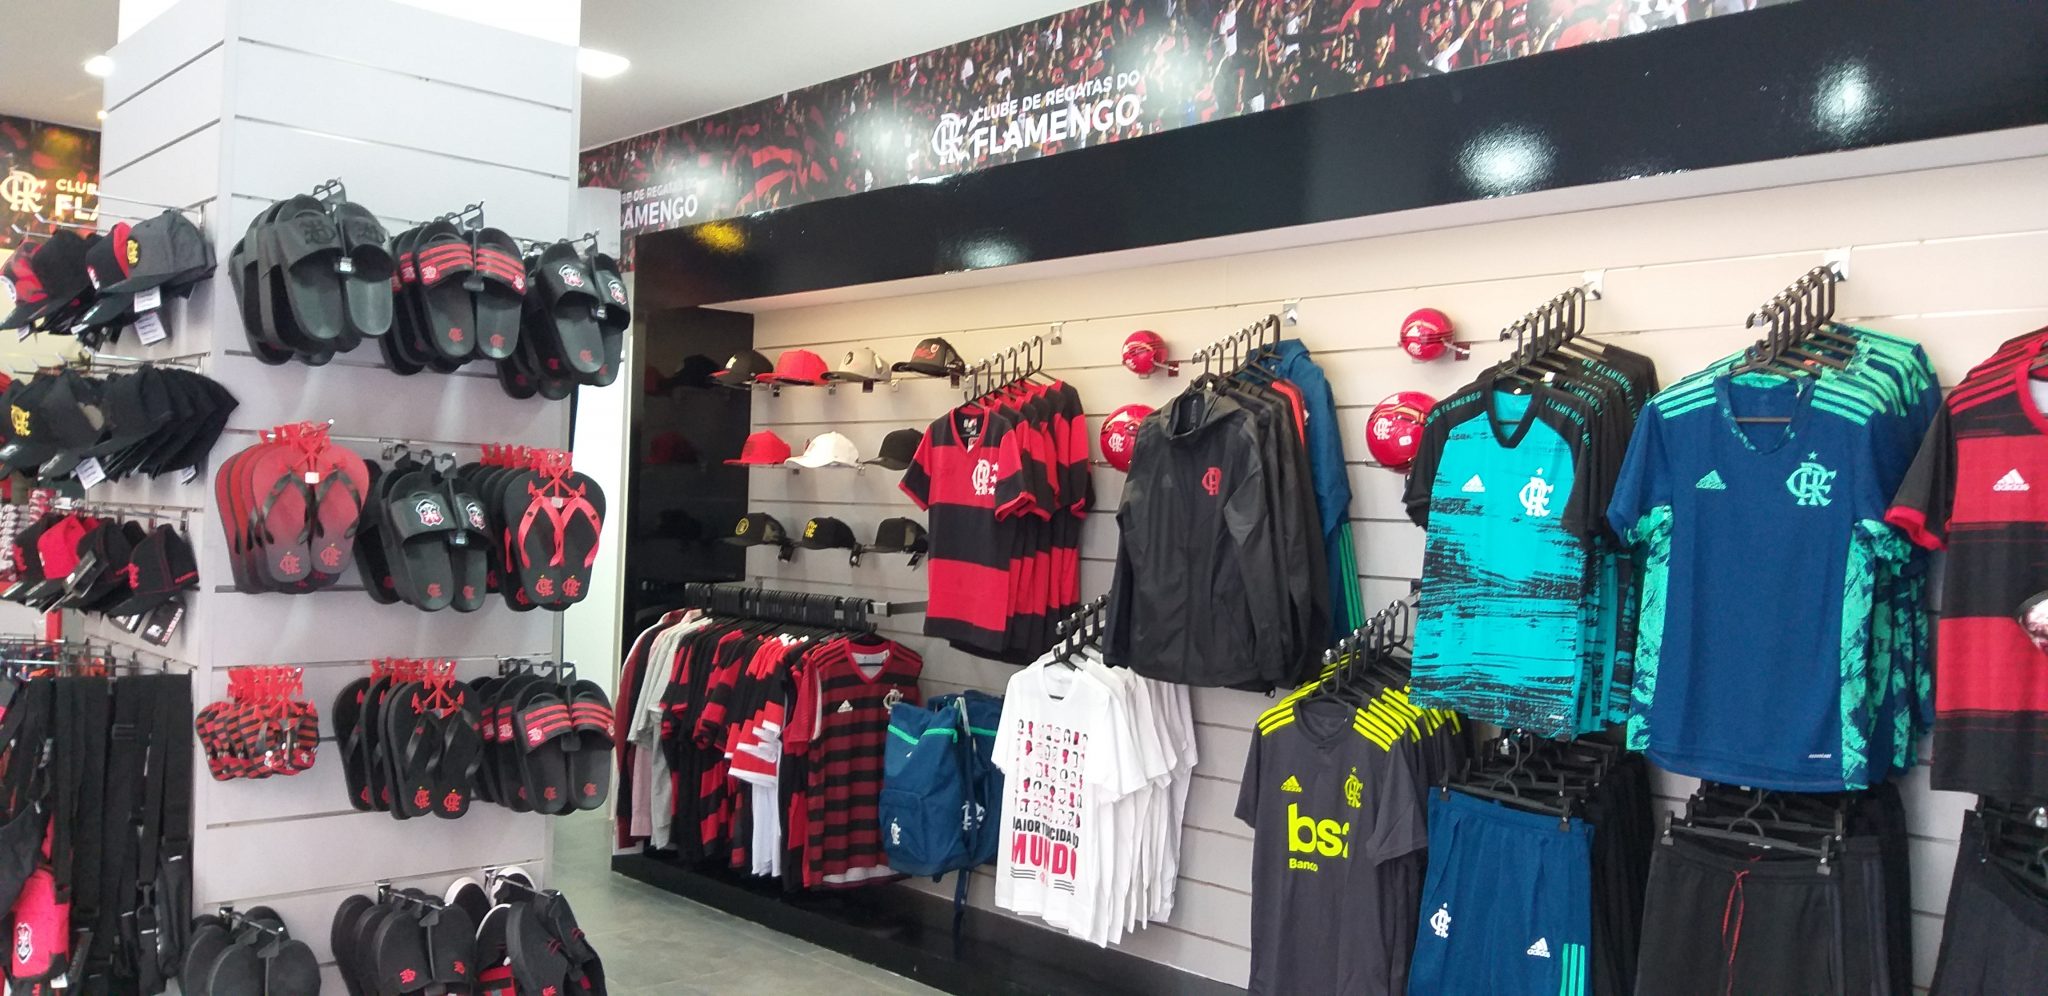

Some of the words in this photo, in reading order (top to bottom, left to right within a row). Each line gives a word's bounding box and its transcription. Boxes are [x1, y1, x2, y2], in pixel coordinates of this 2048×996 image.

[974, 98, 1018, 122] CLUBE
[1022, 93, 1041, 112] DE
[1045, 76, 1113, 107] REGATAS
[1117, 70, 1140, 91] DO
[973, 94, 1141, 158] FLAMENGO
